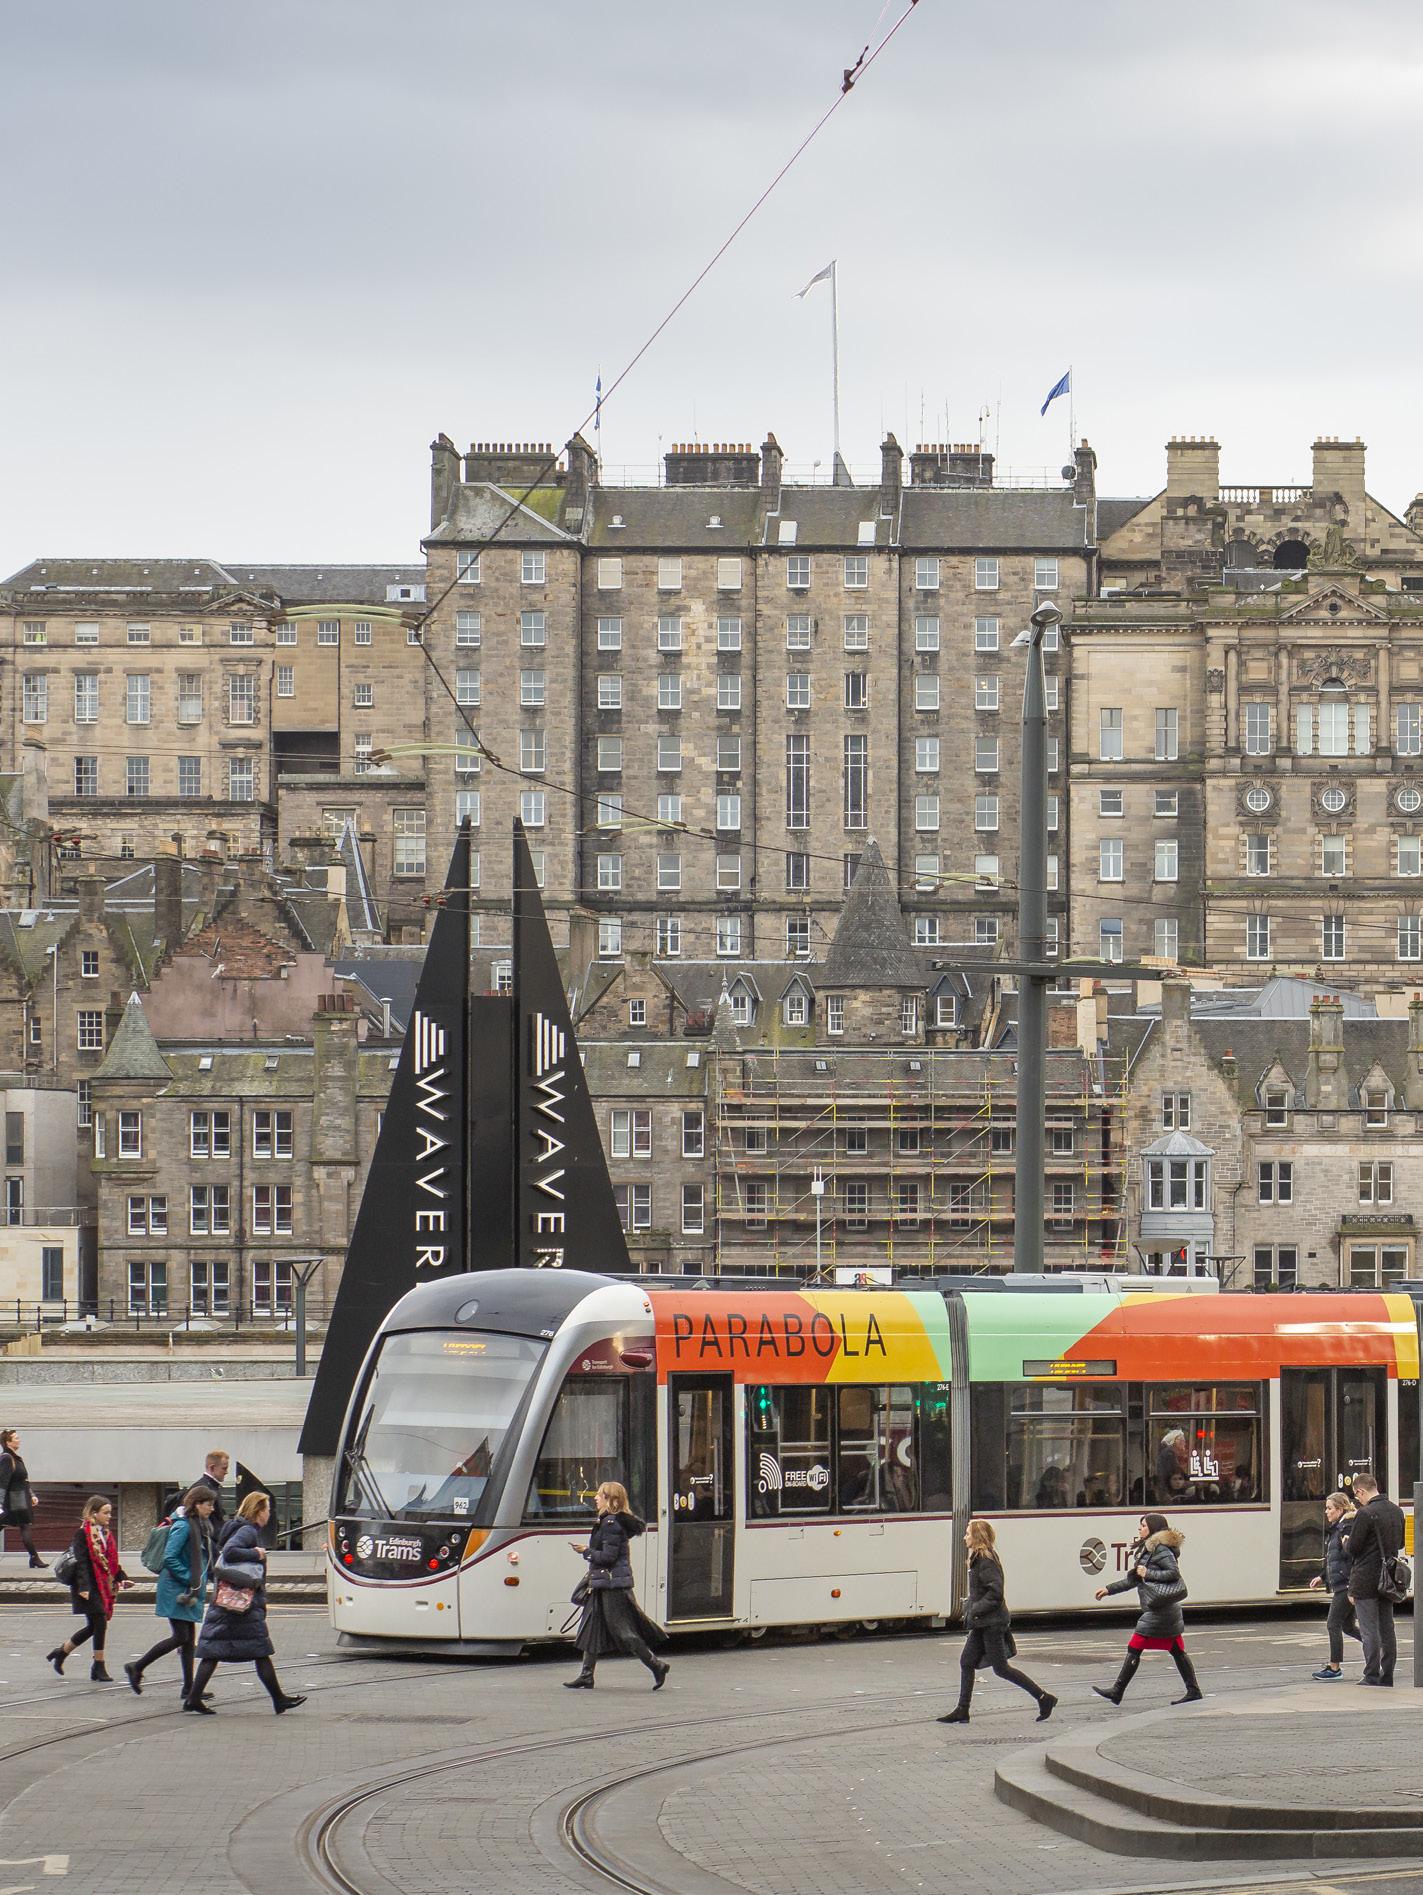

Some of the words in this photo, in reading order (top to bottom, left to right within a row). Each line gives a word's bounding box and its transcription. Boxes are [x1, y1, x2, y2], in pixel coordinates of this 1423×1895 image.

[415, 1067, 448, 1288] WAVER
[540, 1329, 555, 1337] 276
[672, 1312, 888, 1358] PARABOLA
[785, 1470, 807, 1481] FREE
[454, 1501, 468, 1510] 962
[389, 1537, 422, 1548] Edinburgh
[375, 1539, 422, 1561] Trams
